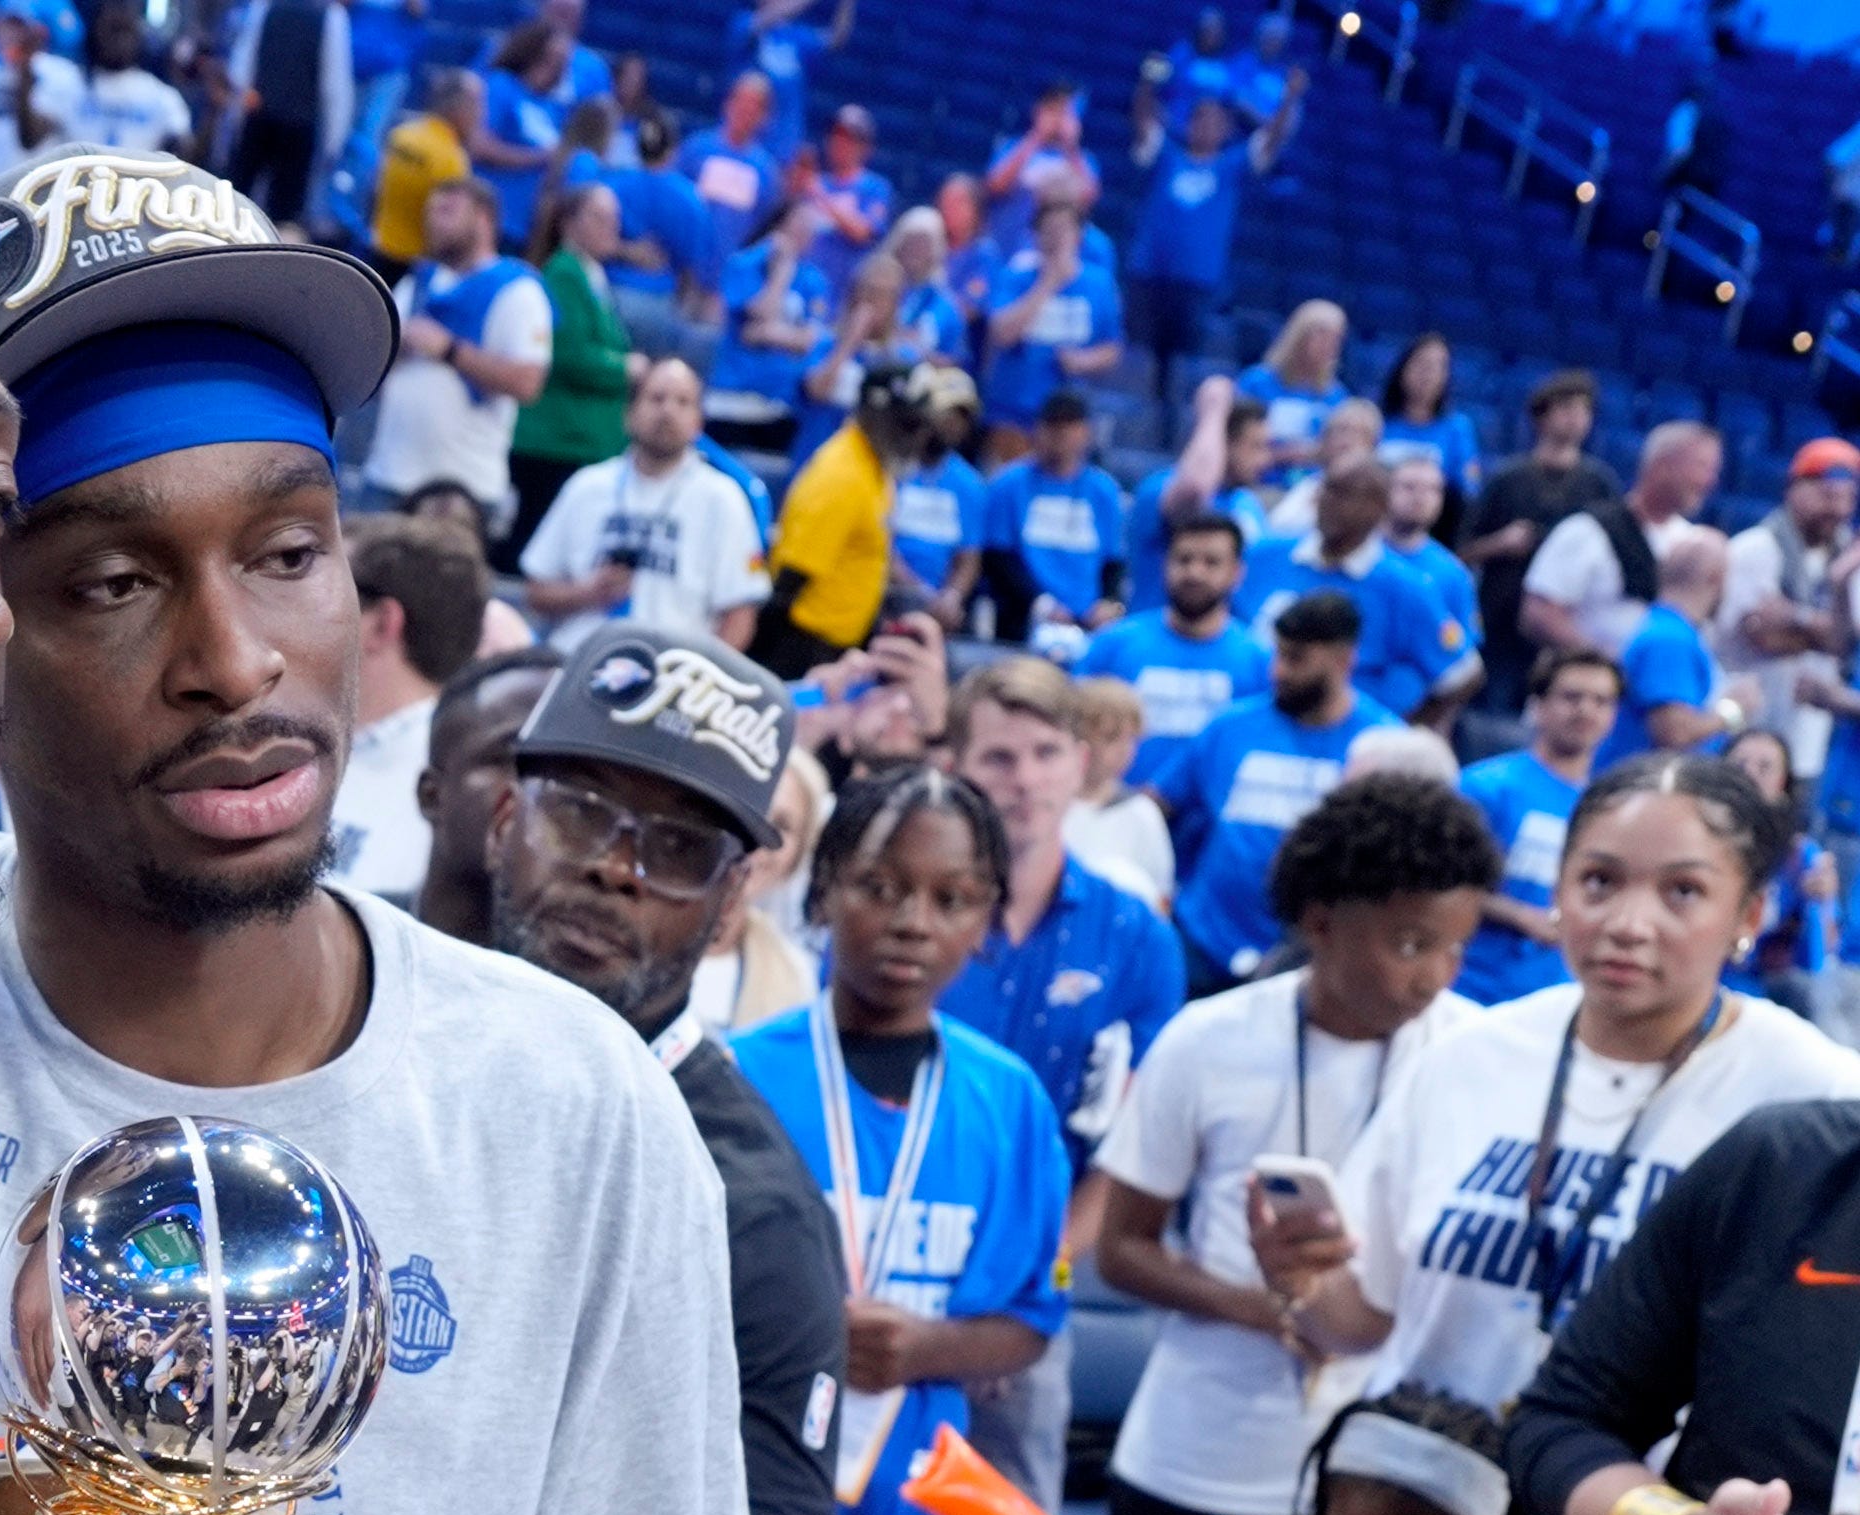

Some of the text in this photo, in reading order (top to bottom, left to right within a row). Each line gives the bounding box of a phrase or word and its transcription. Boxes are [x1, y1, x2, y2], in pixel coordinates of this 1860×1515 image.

[72, 227, 144, 269] 2025
[610, 648, 783, 772] Finals
[391, 1293, 453, 1349] STERN
